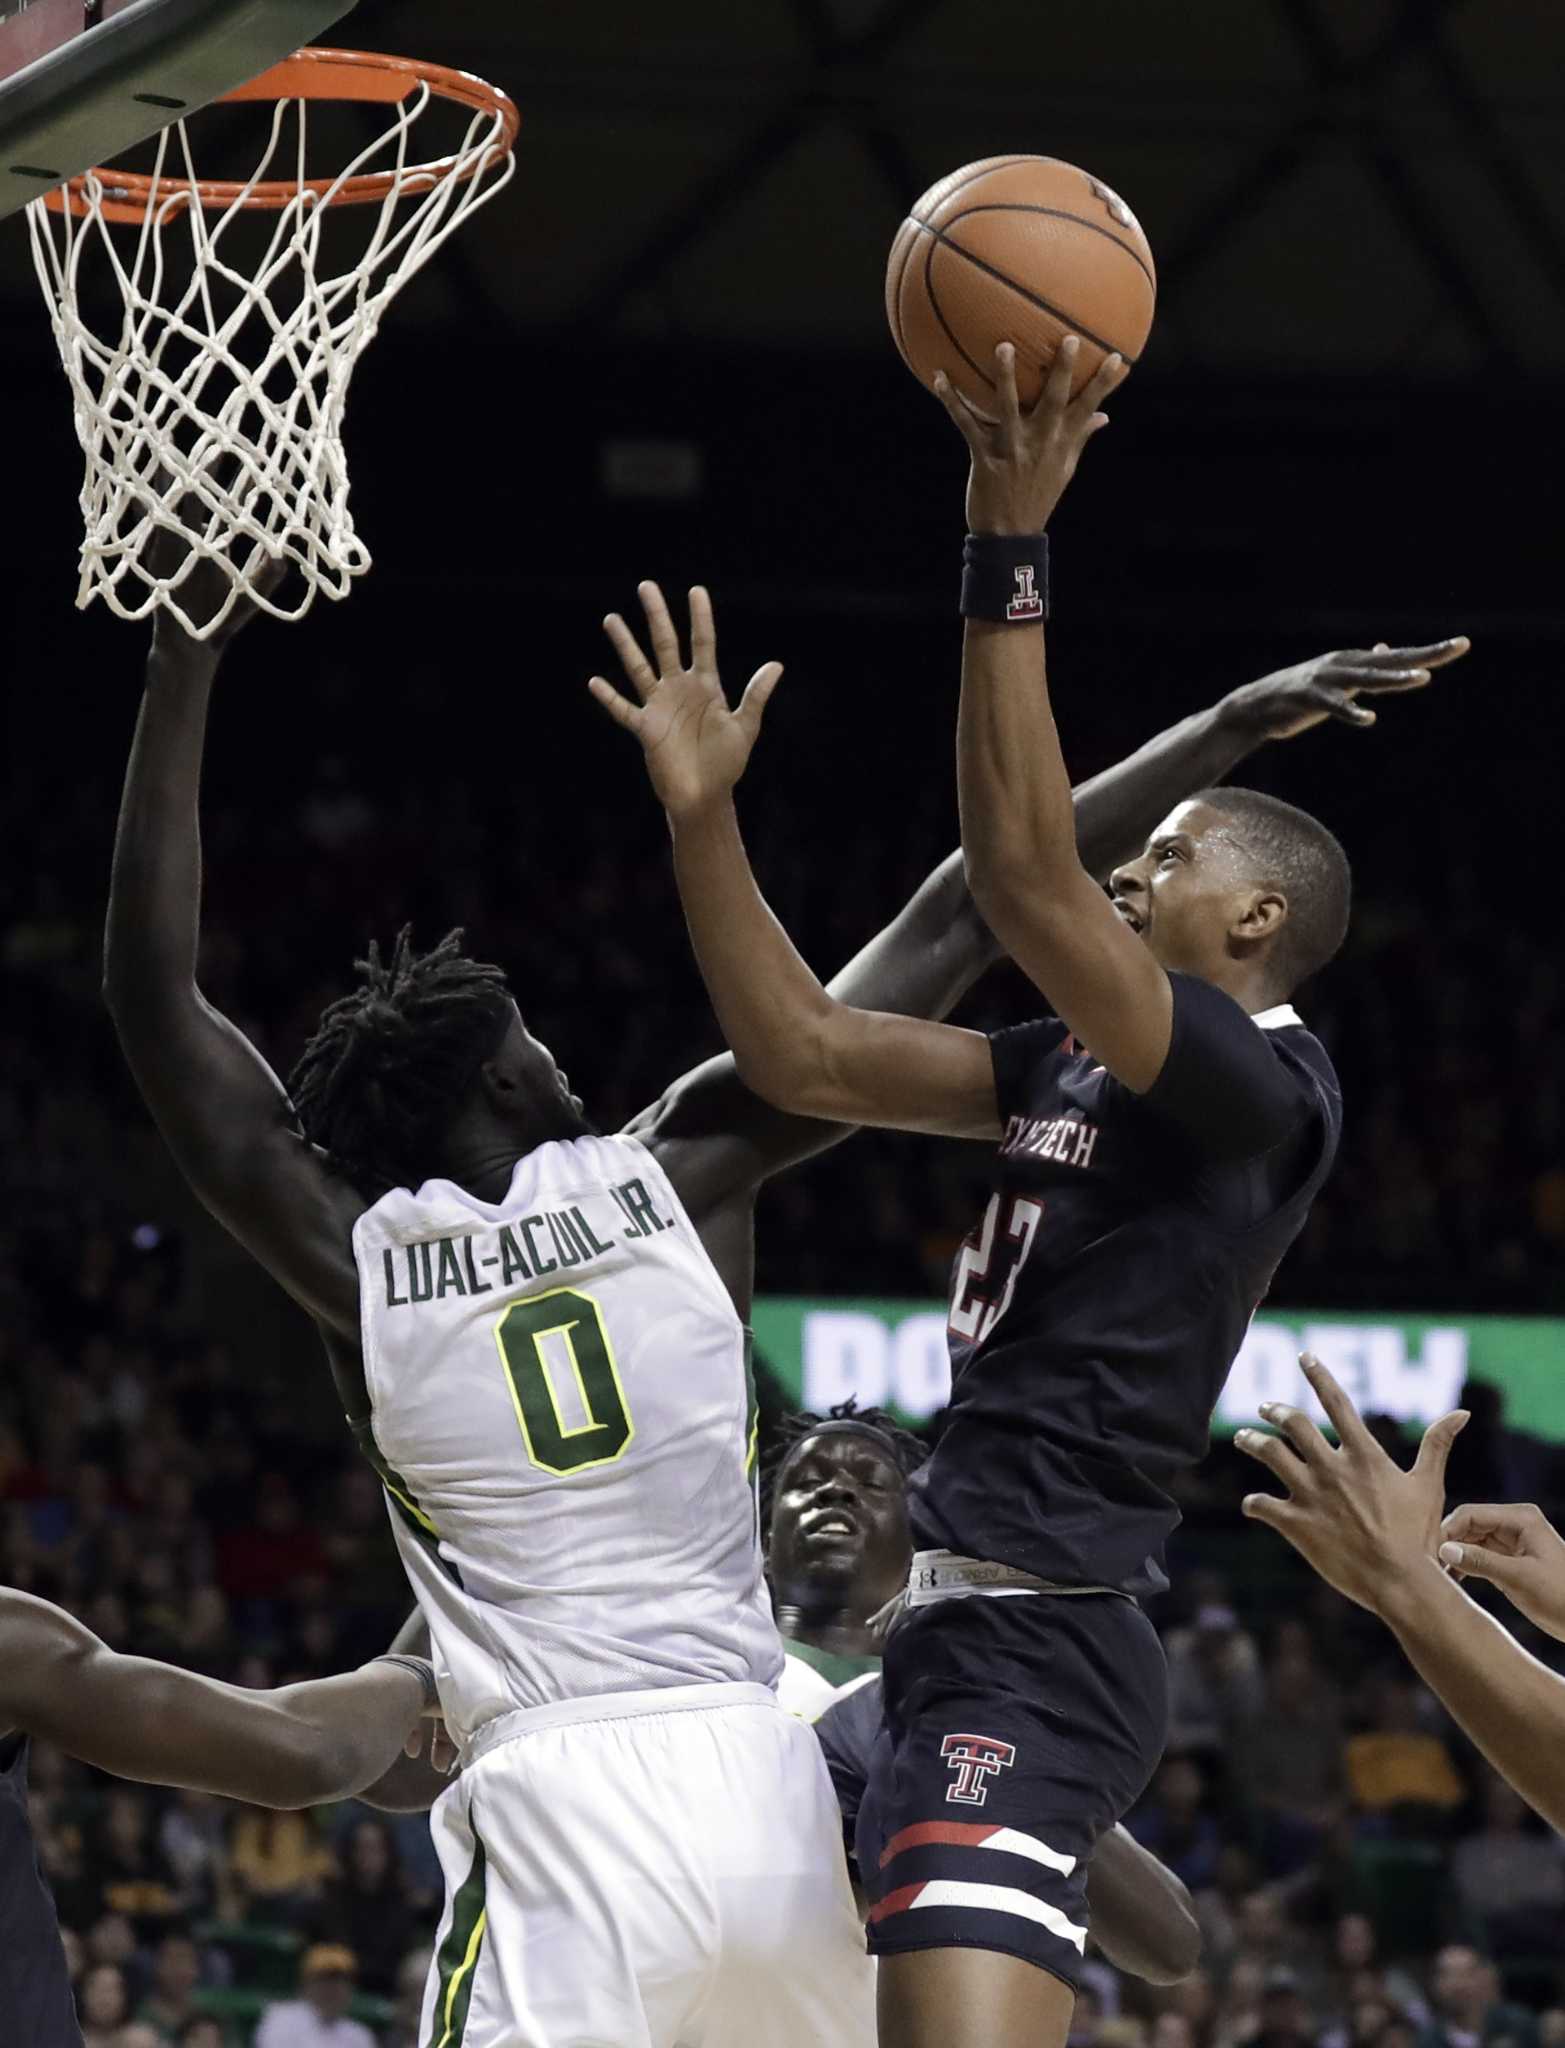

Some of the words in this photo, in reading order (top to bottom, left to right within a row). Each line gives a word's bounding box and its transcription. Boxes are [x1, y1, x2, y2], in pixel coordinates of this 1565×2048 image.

[384, 1206, 615, 1307] LUAL-ACUIL
[609, 1178, 675, 1239] JR.
[948, 1192, 1045, 1344] 23
[492, 1286, 636, 1478] 0
